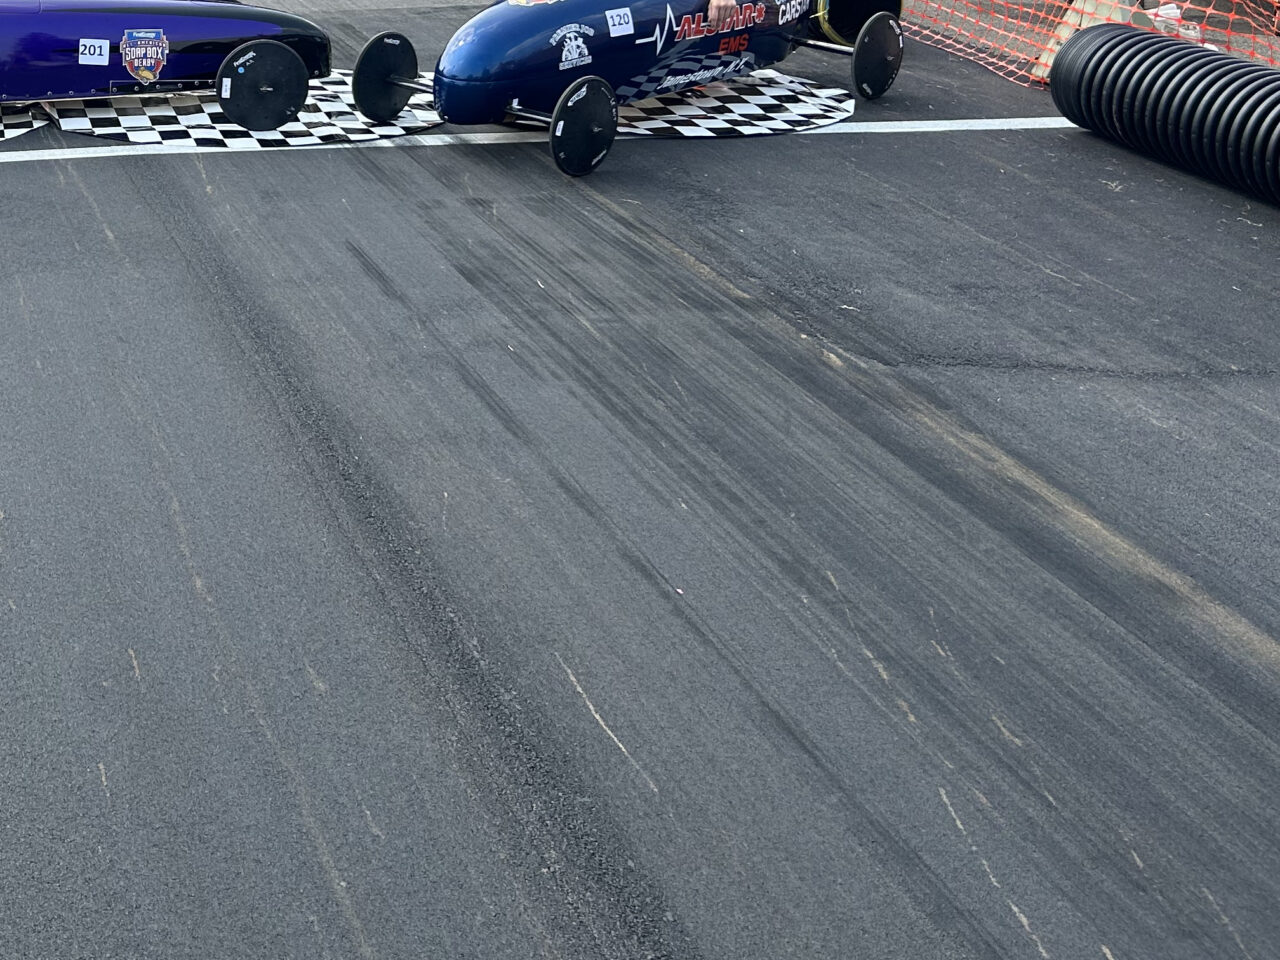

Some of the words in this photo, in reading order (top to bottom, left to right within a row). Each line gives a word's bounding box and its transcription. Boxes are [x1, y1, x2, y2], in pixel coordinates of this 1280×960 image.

[609, 13, 630, 27] 120
[675, 3, 754, 41] ALAR
[80, 44, 104, 57] 201
[718, 34, 750, 55] EMS
[126, 48, 145, 60] SOAP
[147, 47, 163, 60] BOX
[134, 58, 155, 67] DERBY
[657, 66, 722, 89] Jamestown
